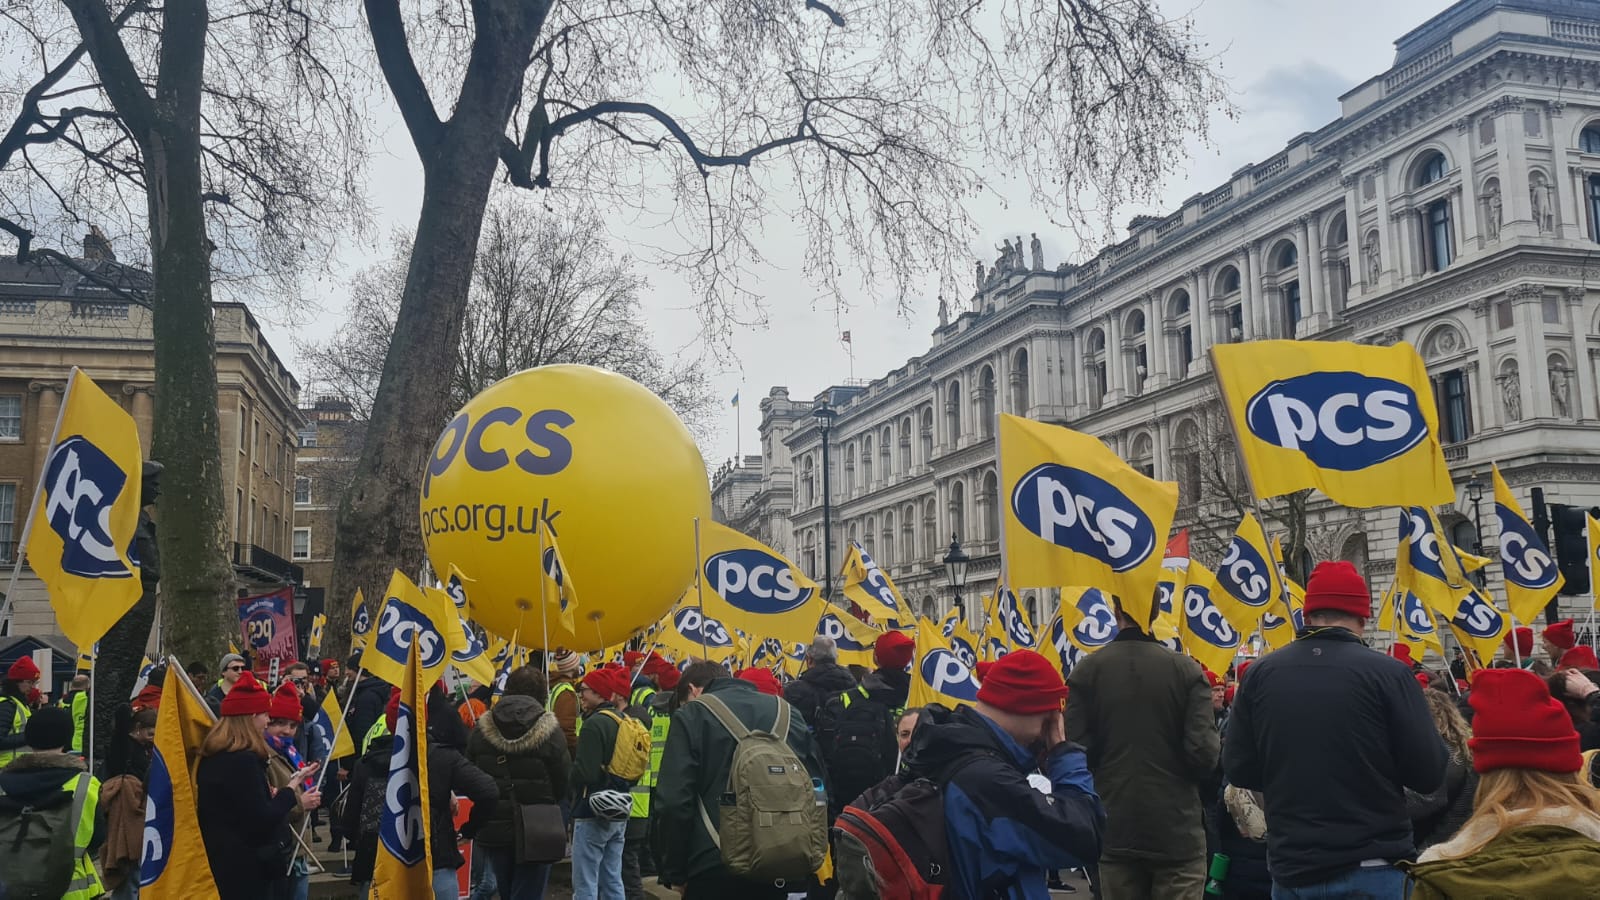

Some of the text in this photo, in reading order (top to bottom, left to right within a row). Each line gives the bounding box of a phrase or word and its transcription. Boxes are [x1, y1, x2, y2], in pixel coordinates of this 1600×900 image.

[1267, 390, 1412, 450] pcs
[423, 406, 576, 499] pcs
[422, 498, 562, 546] pcs.org.uk
[1037, 475, 1139, 560] pcs
[717, 558, 800, 601] pcs
[677, 609, 730, 645] pcs
[1184, 589, 1234, 642] pcs
